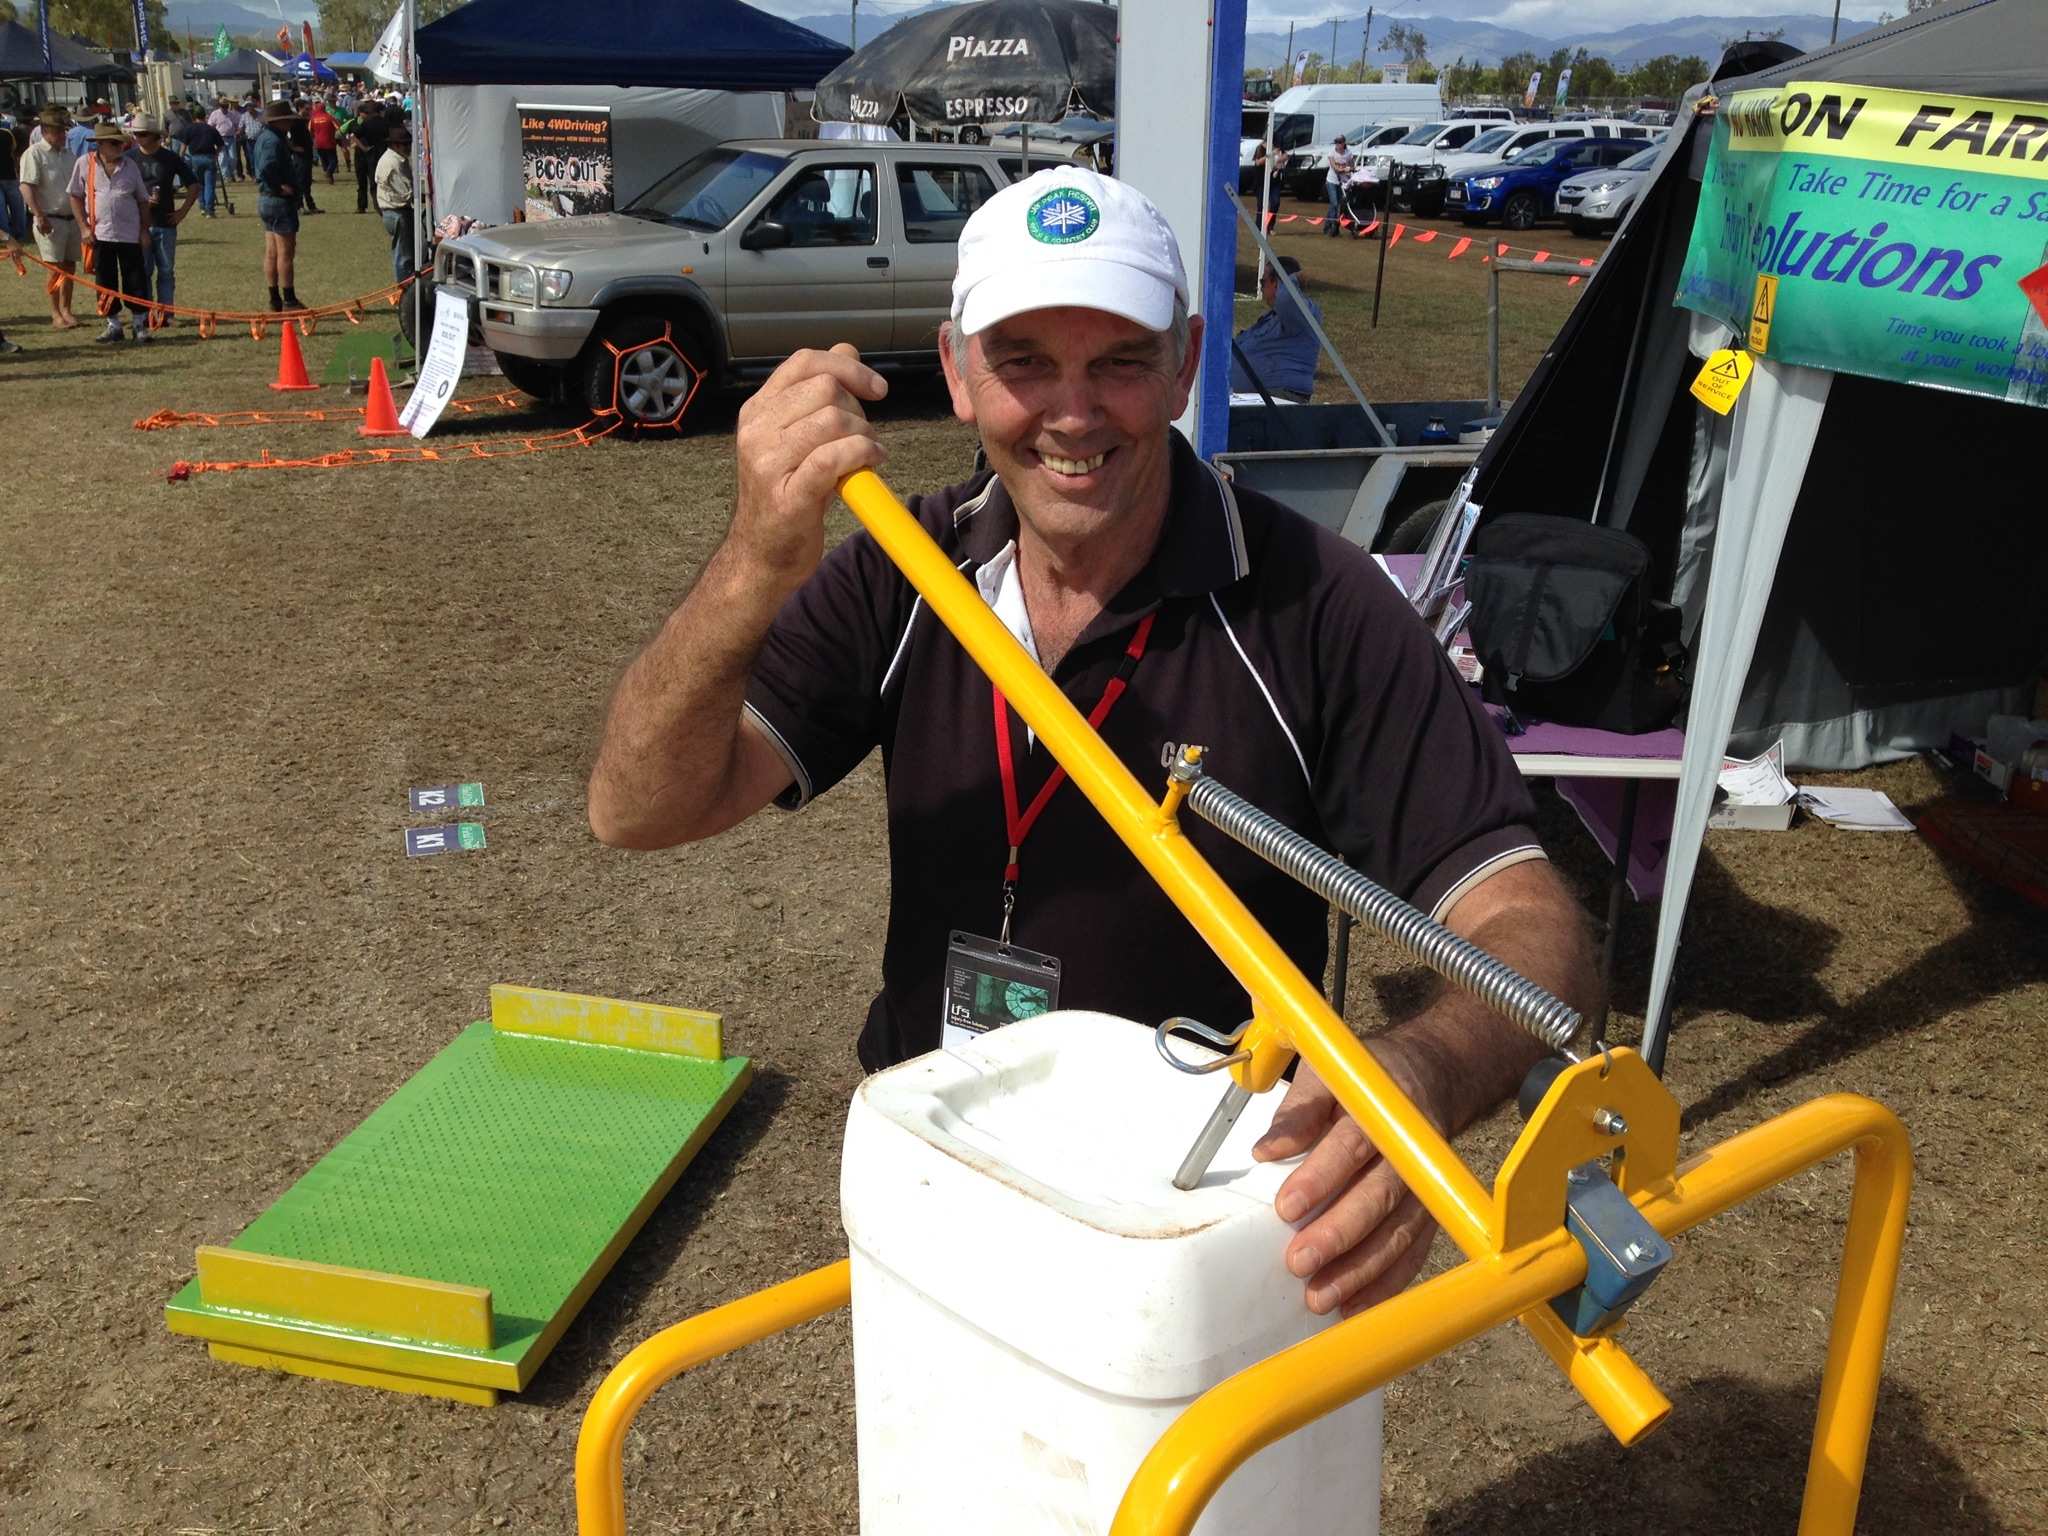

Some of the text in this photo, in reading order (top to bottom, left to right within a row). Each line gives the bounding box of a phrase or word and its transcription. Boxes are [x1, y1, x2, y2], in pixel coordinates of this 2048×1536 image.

[945, 96, 1028, 120] ESPRESSO
[1780, 92, 1868, 140] ON
[521, 118, 608, 134] Like 4WDriving?
[535, 158, 599, 182] BOG OUT
[1787, 163, 1848, 196] Take
[1857, 171, 1931, 206] Time
[1937, 182, 1988, 212] for
[1989, 195, 2012, 216] a
[1886, 317, 1927, 338] Time
[1929, 328, 1964, 345] you
[1968, 333, 2009, 352] took
[1921, 352, 1966, 369] your
[1697, 380, 1734, 400] SERVICE
[1712, 375, 1731, 385] OUT
